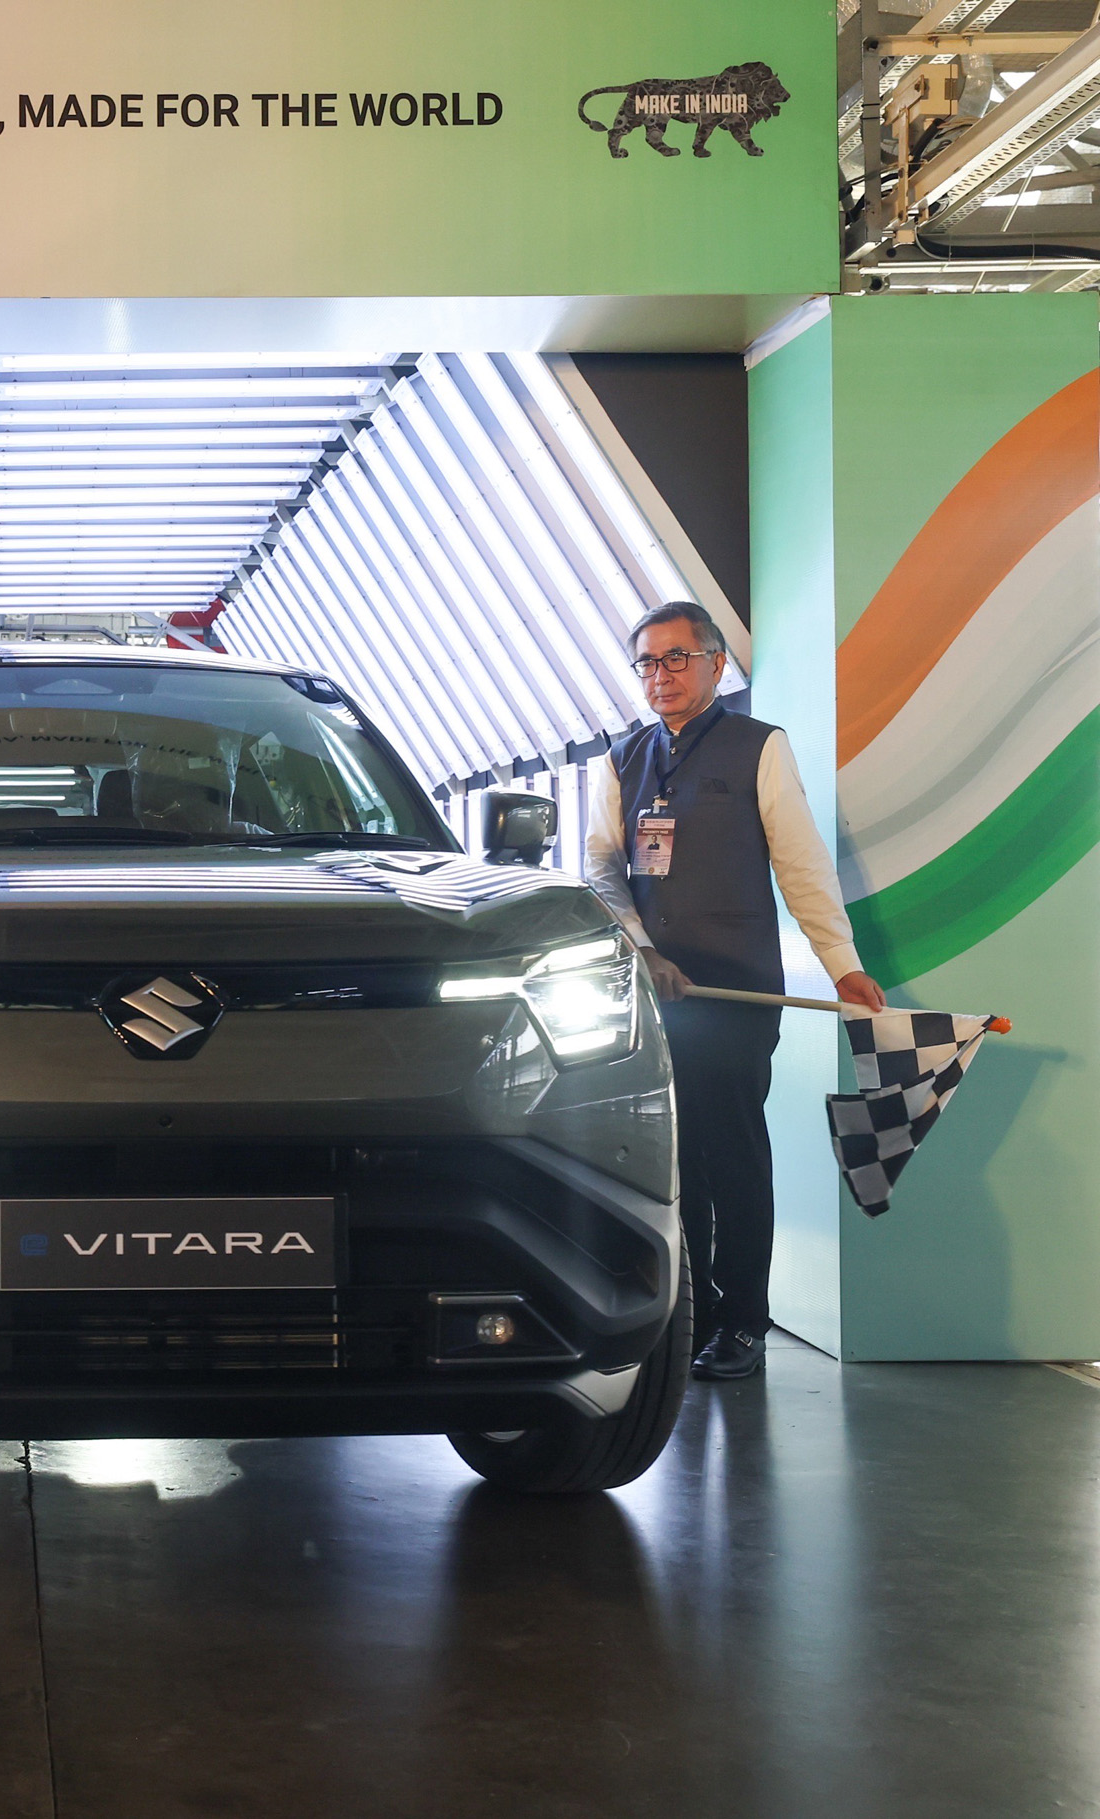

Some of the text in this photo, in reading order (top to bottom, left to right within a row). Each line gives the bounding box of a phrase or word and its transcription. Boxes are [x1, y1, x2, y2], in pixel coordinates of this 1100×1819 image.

[18, 94, 144, 128] MADE
[156, 94, 240, 127] FOR
[251, 93, 338, 127] THE
[348, 92, 504, 126] WORLD
[635, 93, 748, 114] MAKE IN INDIA
[63, 1232, 315, 1256] VITARA
